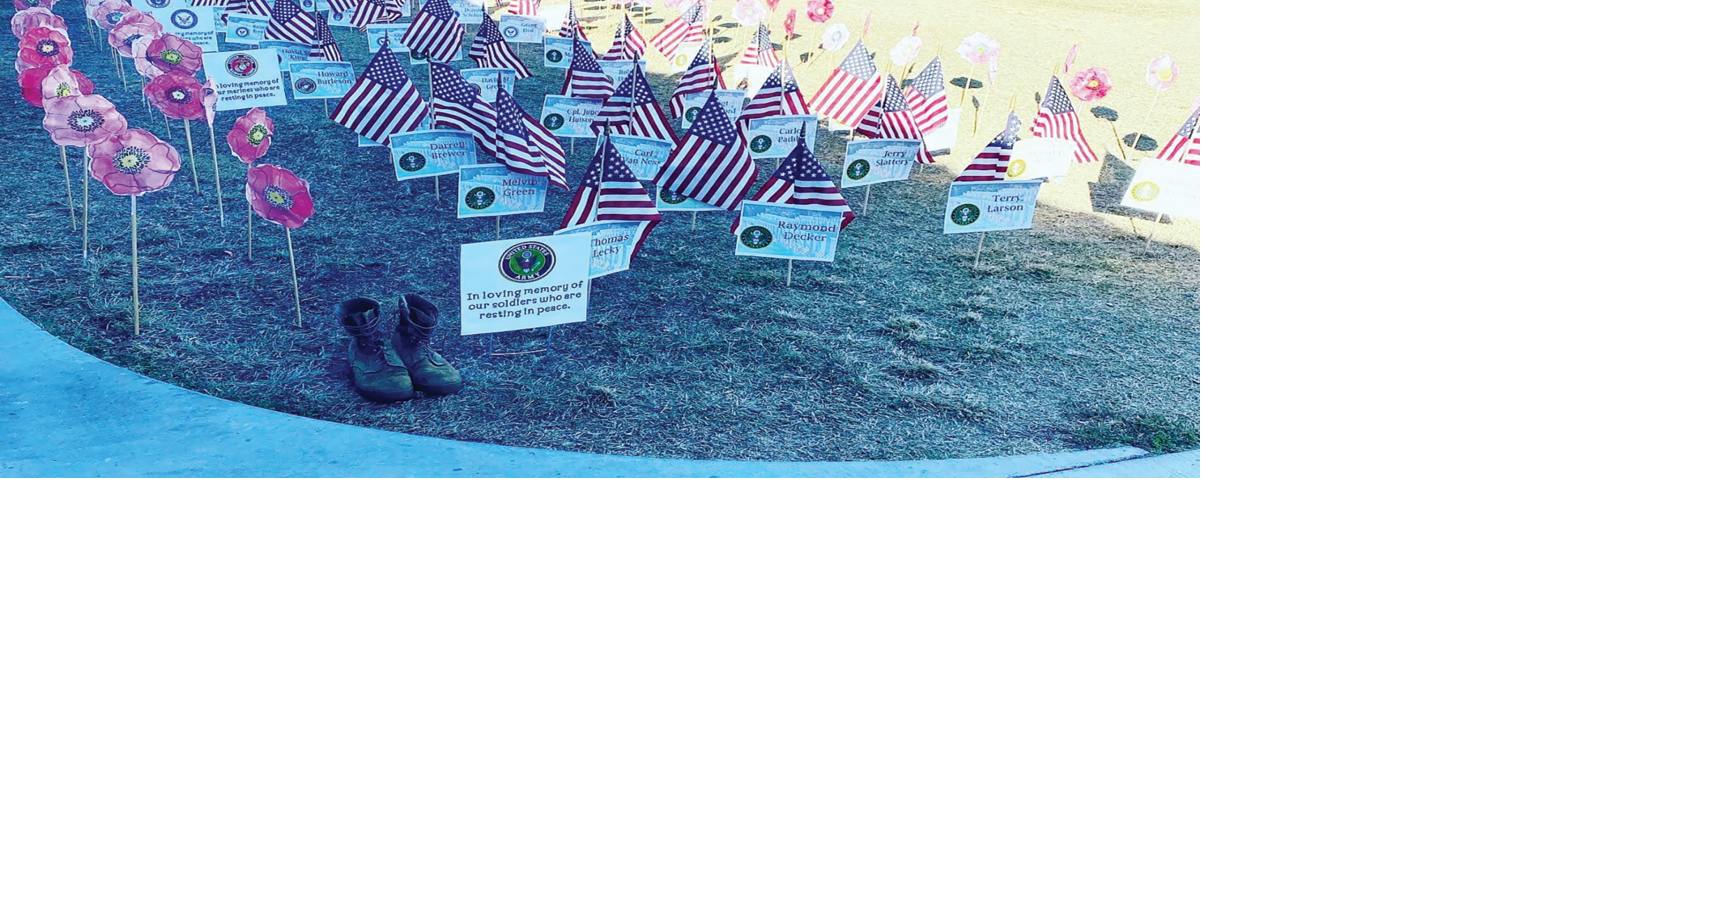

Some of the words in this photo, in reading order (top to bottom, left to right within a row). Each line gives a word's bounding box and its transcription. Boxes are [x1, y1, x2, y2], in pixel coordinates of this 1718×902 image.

[430, 141, 466, 151] Darrell
[431, 150, 466, 160] Brewer
[635, 149, 654, 157] Carl
[882, 150, 907, 158] Jerry
[875, 158, 909, 166] Slattery
[502, 178, 538, 187] Melvin
[503, 187, 535, 197] Green
[987, 204, 1024, 213] Larson
[778, 220, 836, 233] Raymond
[783, 231, 827, 242] Decker
[505, 245, 527, 260] UNITED
[529, 244, 550, 257] STATES
[593, 245, 621, 258] Lecky
[515, 271, 541, 280] ARMY
[466, 292, 480, 301] In
[482, 289, 522, 298] loving
[523, 283, 569, 295] memory
[570, 280, 584, 289] of
[468, 303, 490, 311] our
[492, 298, 537, 309] soldiers
[539, 294, 562, 303] who
[564, 291, 582, 300] are
[479, 309, 522, 319] resting
[523, 307, 535, 315] in
[537, 303, 571, 316] peace.
